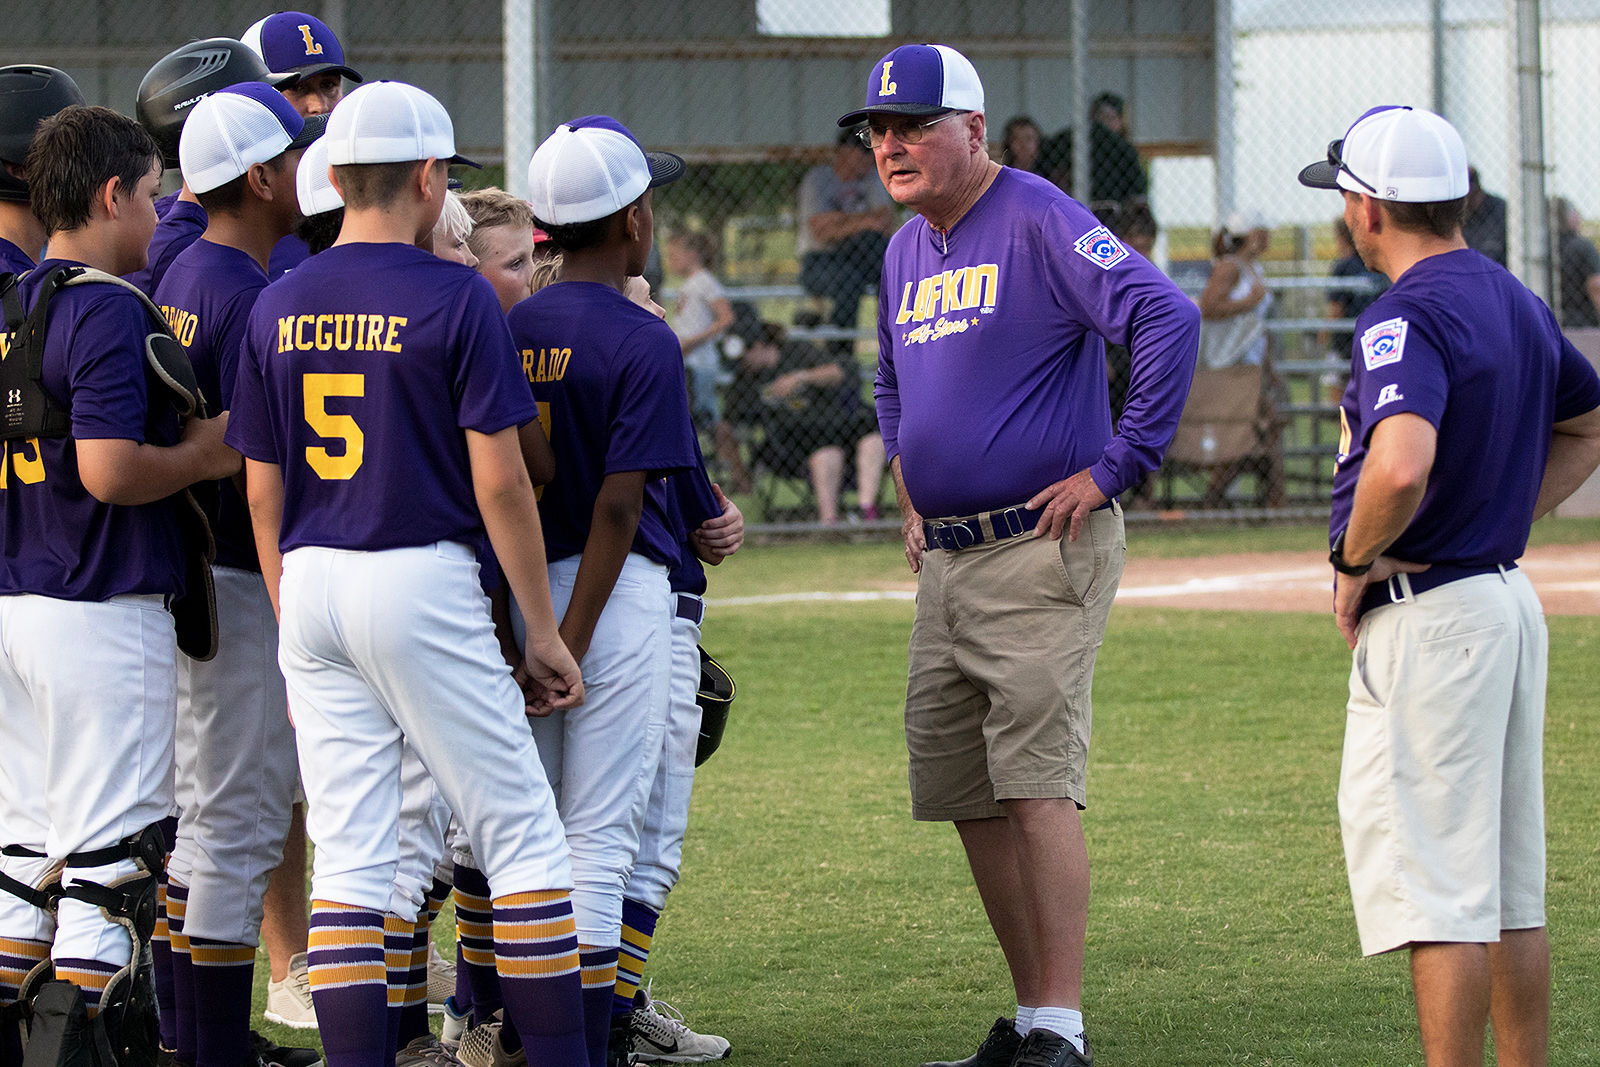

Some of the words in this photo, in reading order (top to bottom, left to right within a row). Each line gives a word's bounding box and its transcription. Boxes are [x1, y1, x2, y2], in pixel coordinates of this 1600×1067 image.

[297, 24, 324, 56] L
[878, 60, 897, 97] L
[895, 263, 998, 325] LUFKIN
[277, 313, 408, 354] MCGUIRE
[517, 347, 572, 383] RADO
[303, 373, 365, 480] 5
